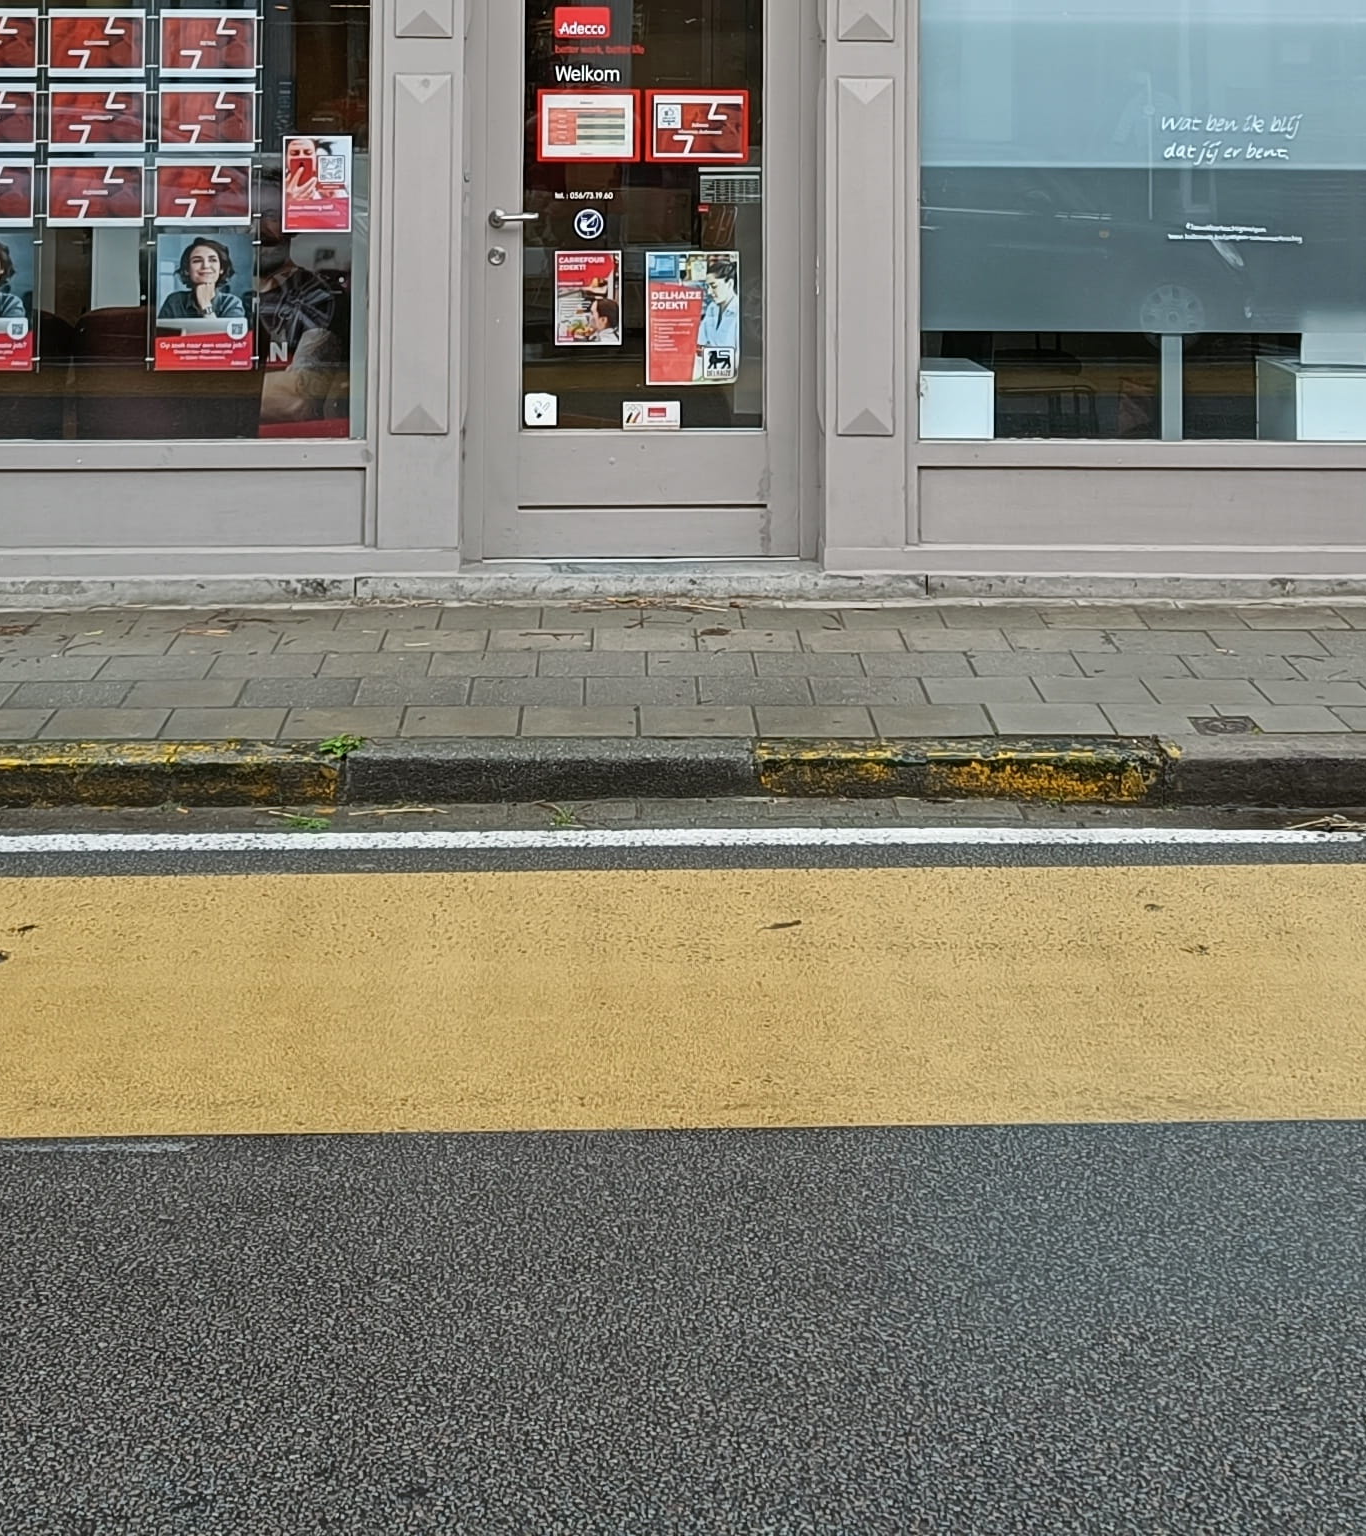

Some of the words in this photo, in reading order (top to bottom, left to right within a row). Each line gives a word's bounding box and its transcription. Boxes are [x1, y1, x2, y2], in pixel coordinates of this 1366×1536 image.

[558, 21, 606, 35] Adecco
[554, 64, 620, 82] Welkom
[1161, 116, 1202, 131] Wat
[1205, 114, 1238, 132] ben
[1243, 114, 1265, 133] ik
[1270, 114, 1303, 139] blij
[1163, 142, 1196, 159] dat
[1193, 140, 1222, 165] jij
[1223, 146, 1242, 158] er
[651, 291, 702, 300] DELHAIZE
[651, 301, 688, 310] ZOEKT!
